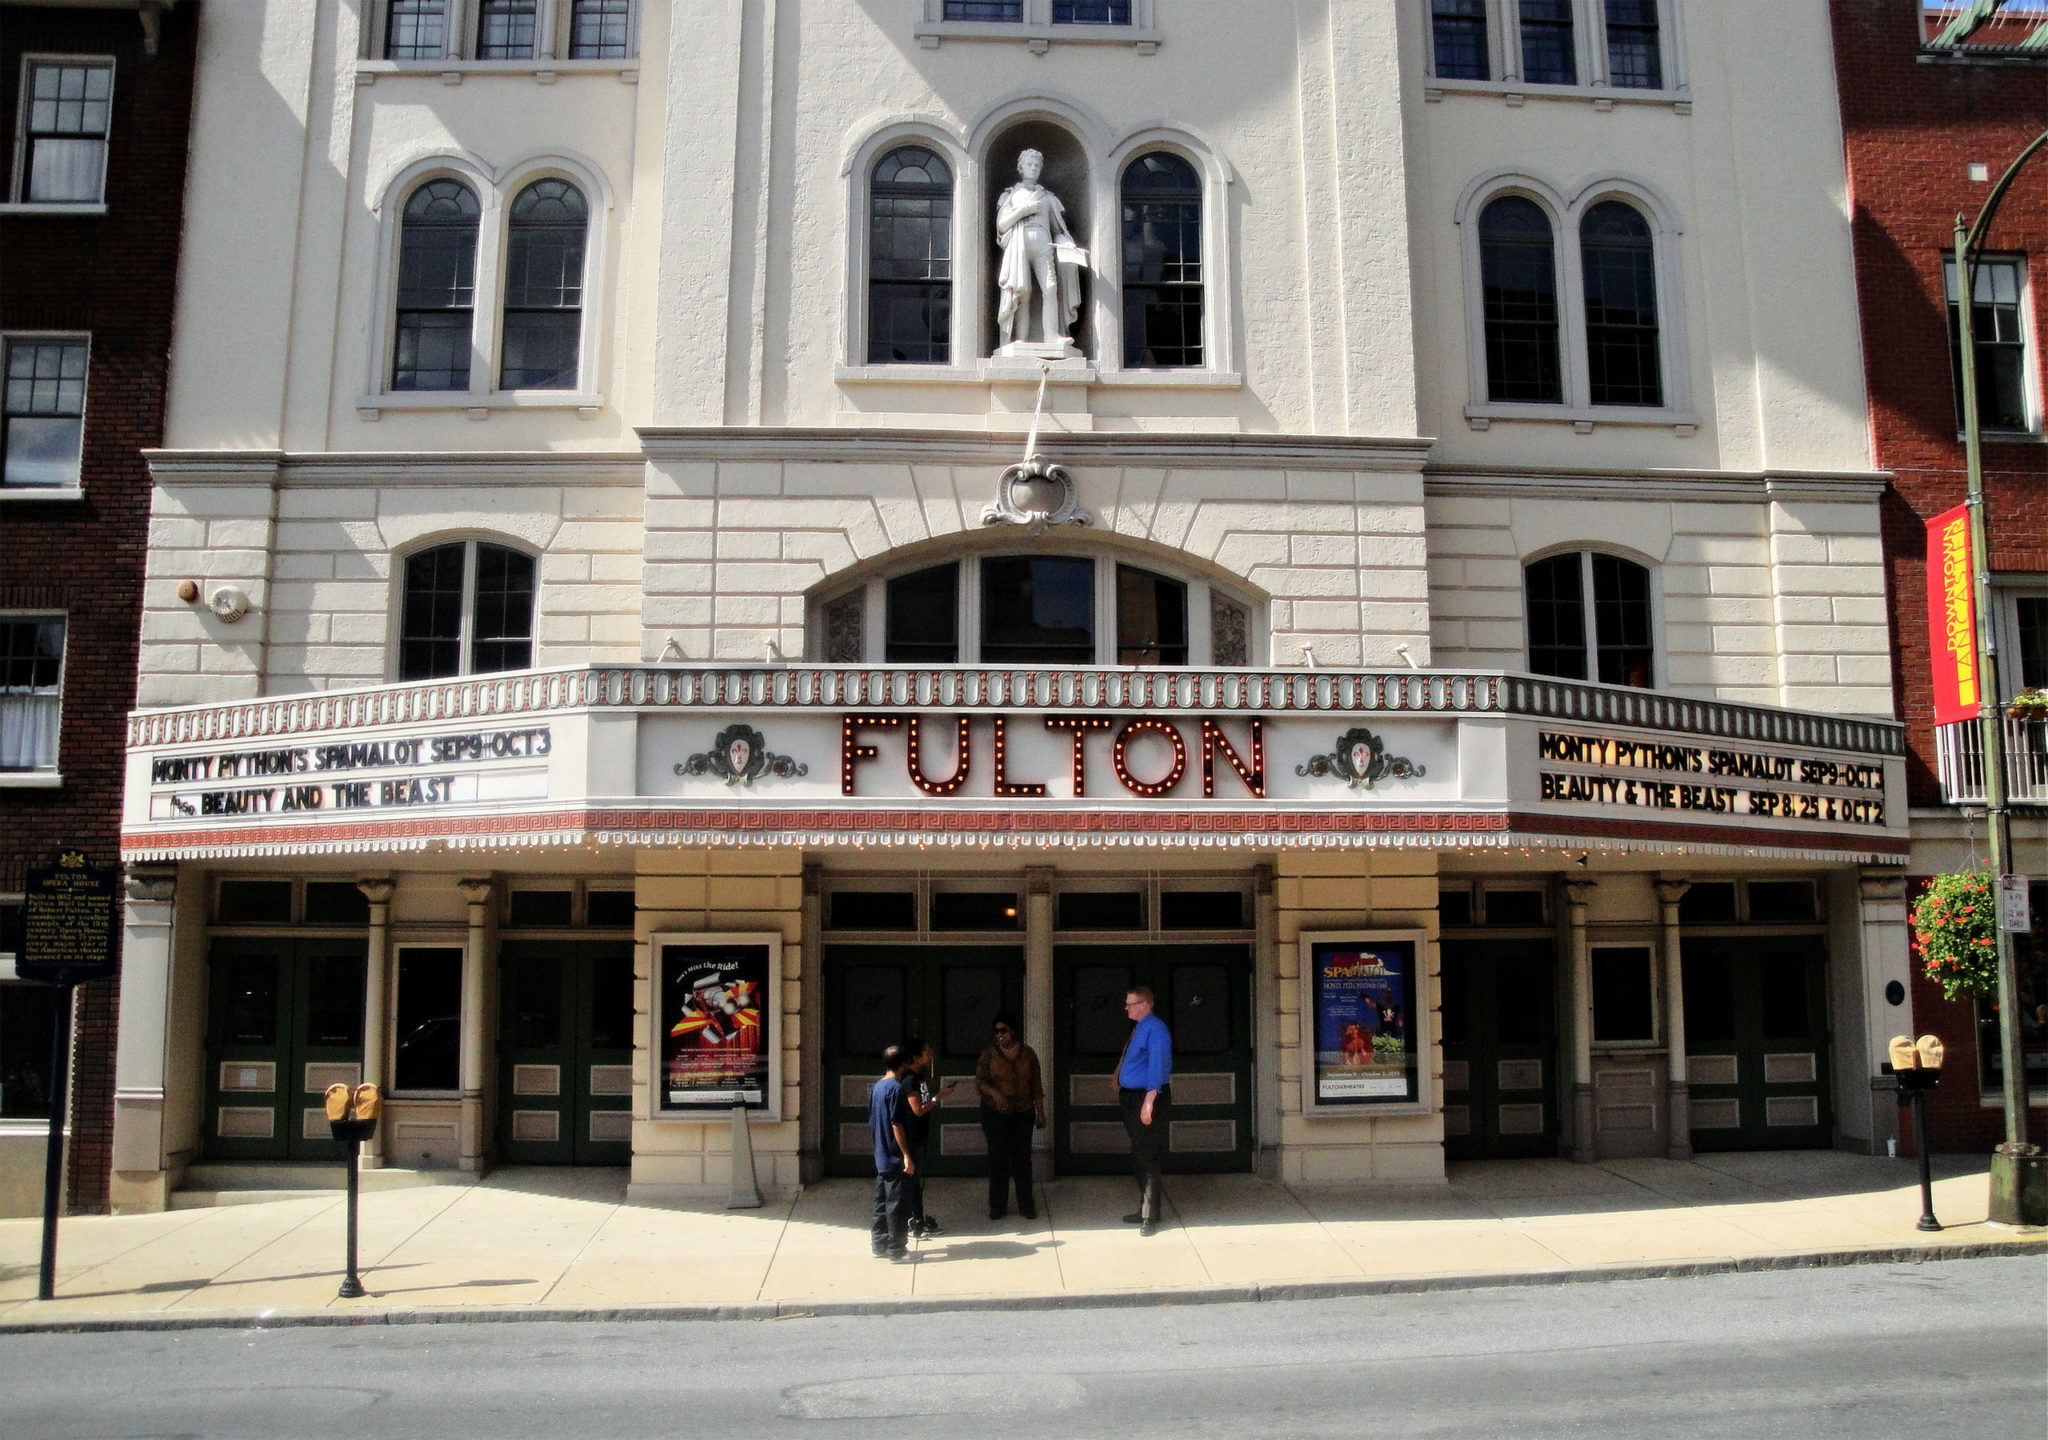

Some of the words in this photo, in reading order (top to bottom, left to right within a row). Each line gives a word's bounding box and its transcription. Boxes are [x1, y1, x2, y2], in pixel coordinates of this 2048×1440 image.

[1943, 524, 1957, 652] DOWNTOWN
[1951, 517, 1974, 685] LANCASTER
[152, 756, 214, 782] MONTY
[218, 749, 309, 777] PYTHON'S
[315, 739, 423, 770] SPAMALOT
[841, 713, 1266, 798] FULTON
[1539, 732, 1610, 764] MONTY
[1615, 740, 1703, 773] PYTHON'S
[1708, 751, 1795, 782] SPAMALOT
[202, 788, 275, 815] BEAUTY
[282, 785, 323, 811] AND
[332, 781, 372, 809] THE
[381, 776, 455, 806] BEAST
[1540, 772, 1621, 803] BEAUTY
[1624, 780, 1638, 804] &
[1641, 781, 1677, 809] THE
[1680, 785, 1738, 812] BEAST
[1800, 795, 1819, 819] 25
[1826, 797, 1836, 821] &
[703, 961, 717, 969] the
[717, 961, 739, 971] Ride!
